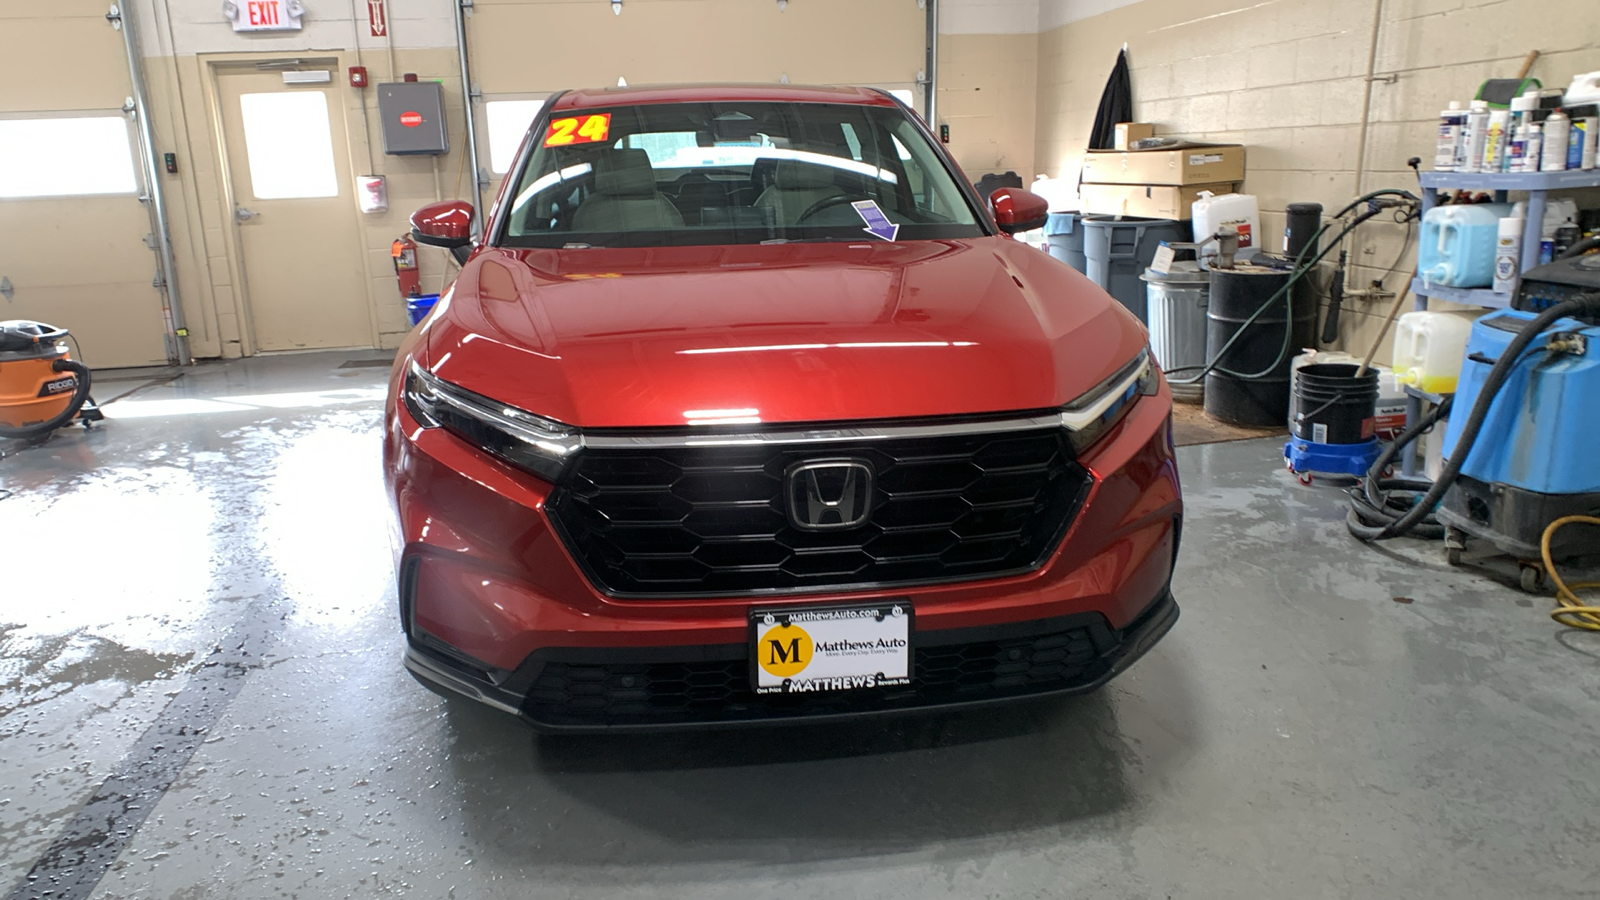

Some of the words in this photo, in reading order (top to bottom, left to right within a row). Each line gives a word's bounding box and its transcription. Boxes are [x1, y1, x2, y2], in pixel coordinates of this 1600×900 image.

[248, 1, 279, 26] EXIT
[546, 115, 607, 145] 24
[788, 609, 880, 622] MatthewsAuto.com
[767, 637, 803, 665] M
[815, 639, 874, 652] Matthews
[876, 638, 906, 648] Auto
[788, 675, 876, 693] MATTHEWS
